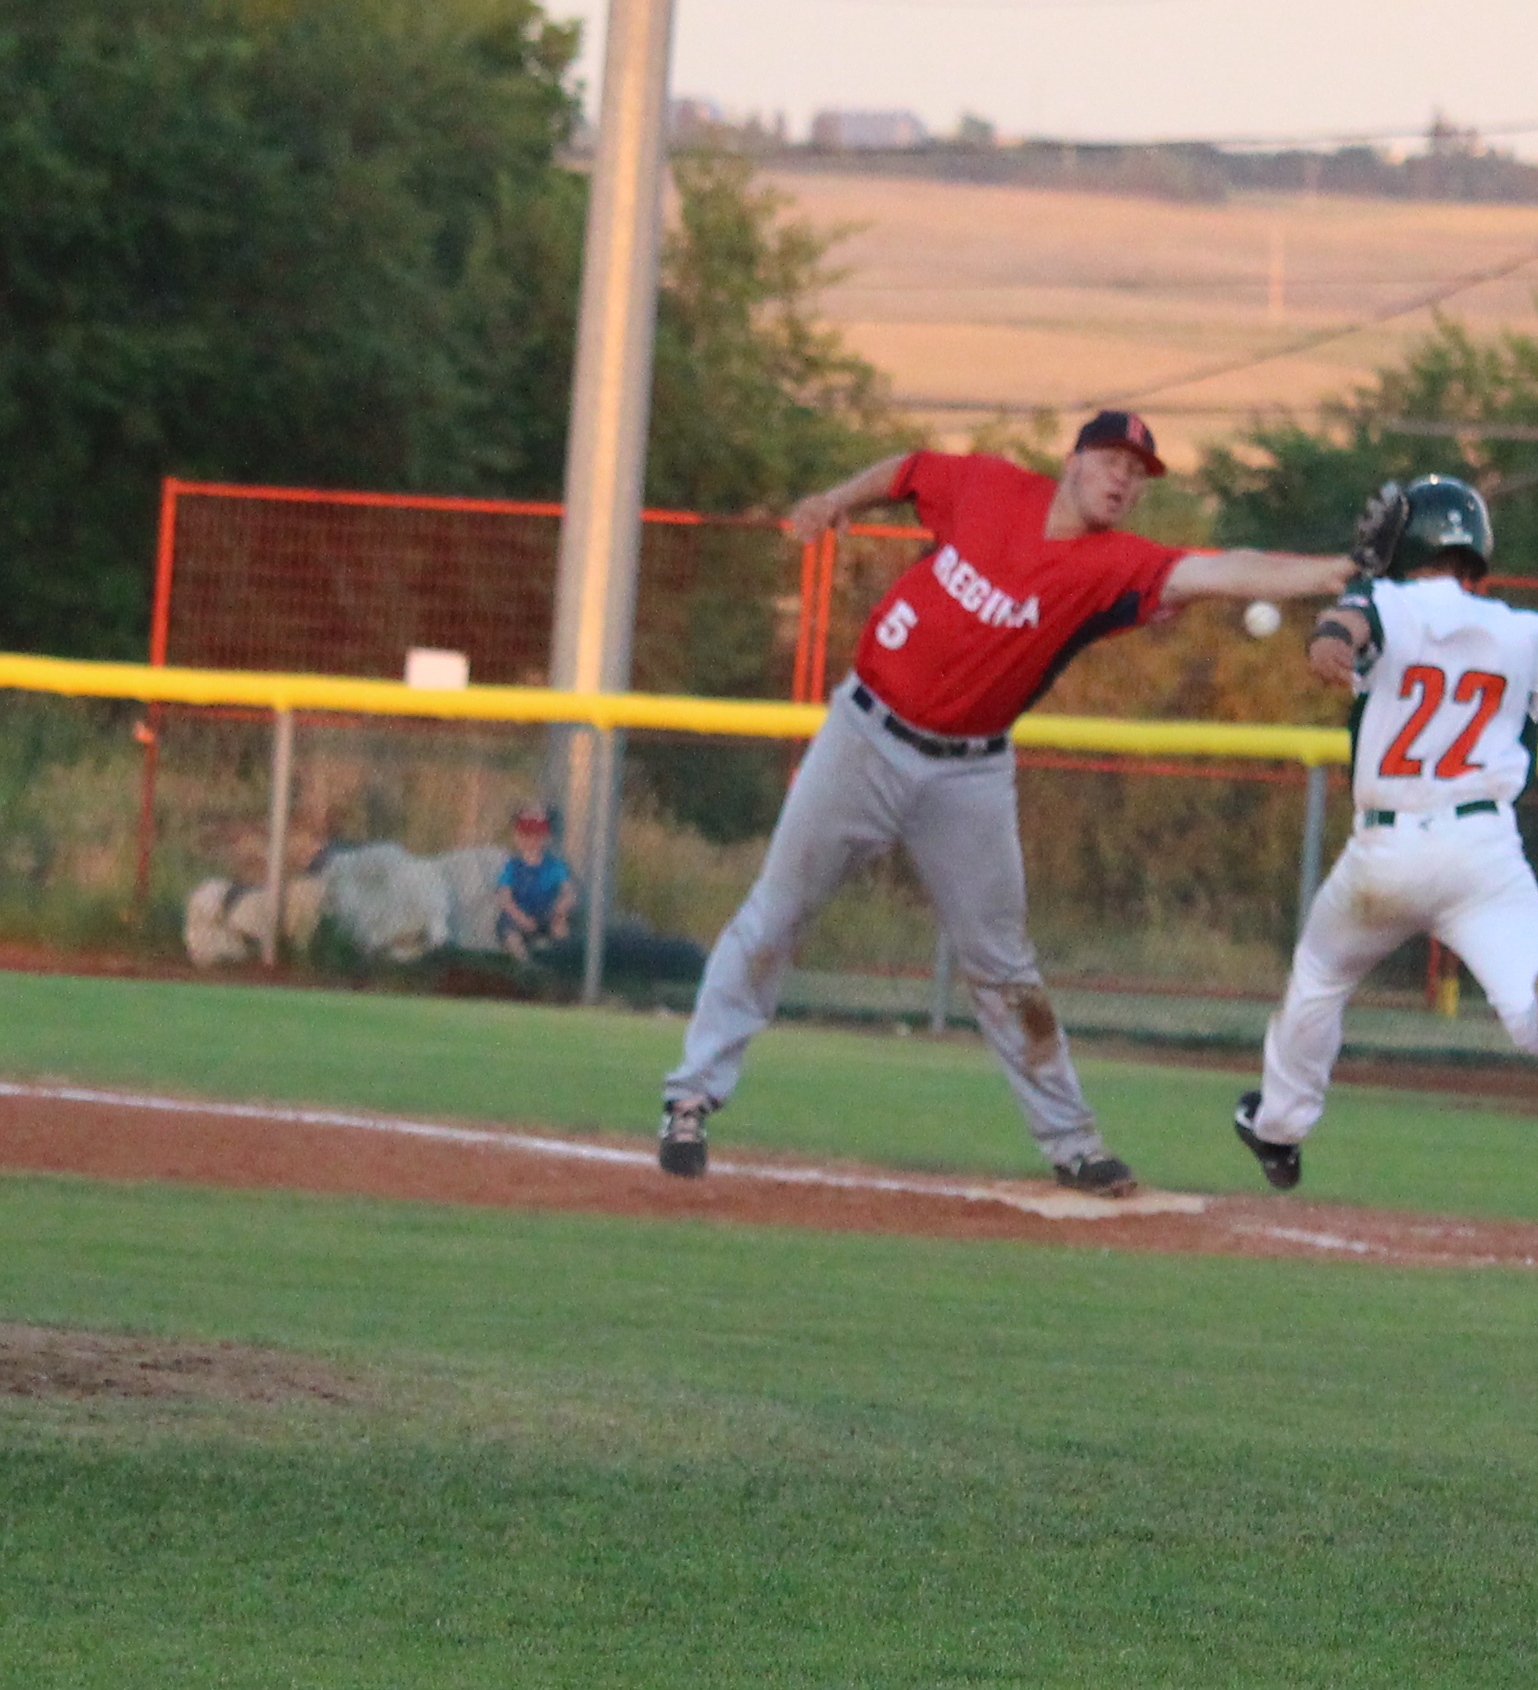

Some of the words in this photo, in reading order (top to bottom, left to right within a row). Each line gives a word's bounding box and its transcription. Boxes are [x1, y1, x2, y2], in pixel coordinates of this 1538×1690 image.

[875, 599, 918, 649] 5
[933, 543, 1040, 629] REGINA
[1379, 664, 1507, 778] 22
